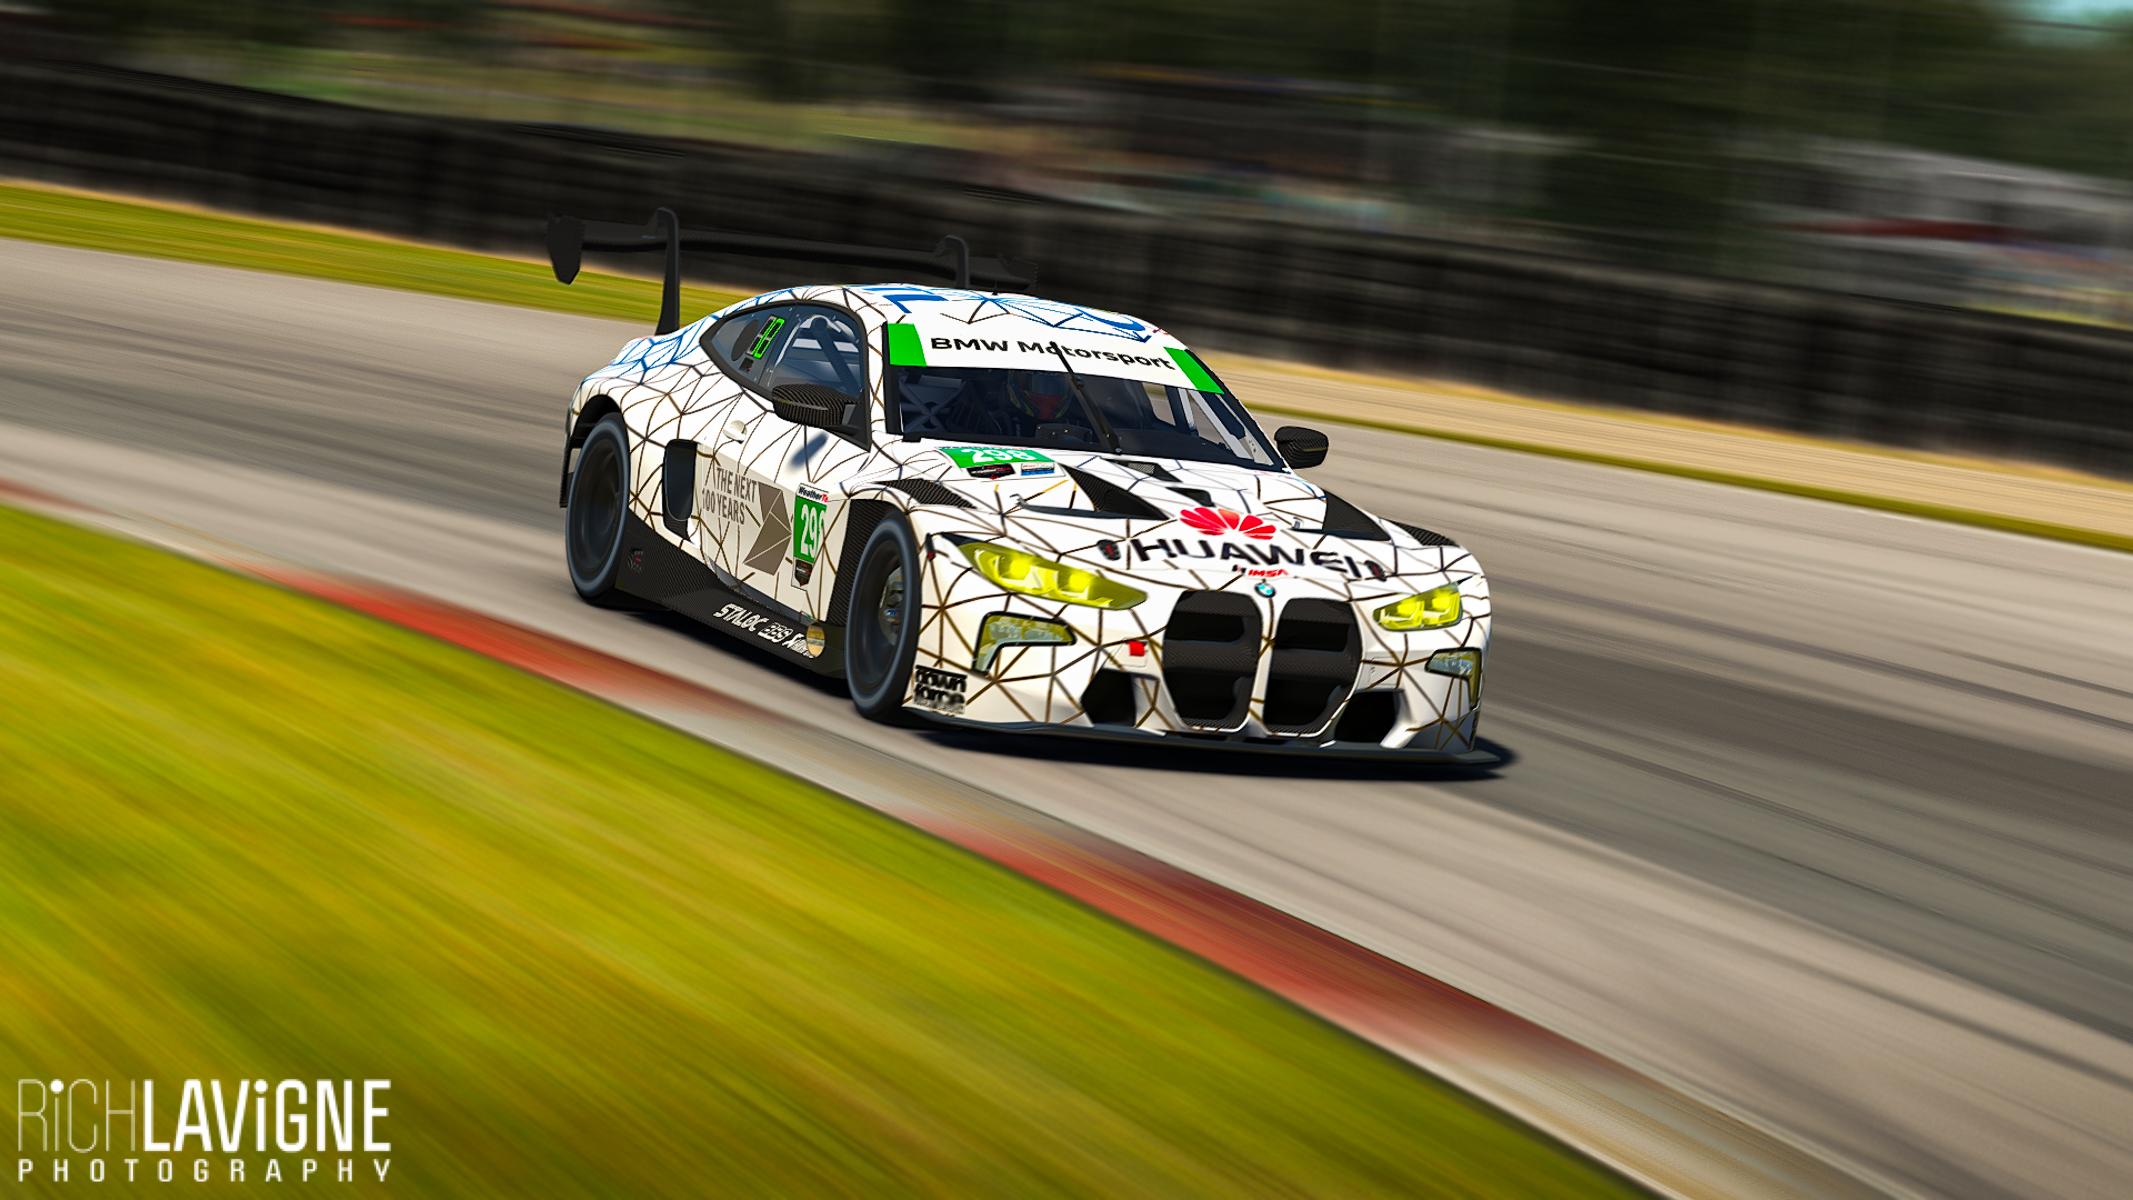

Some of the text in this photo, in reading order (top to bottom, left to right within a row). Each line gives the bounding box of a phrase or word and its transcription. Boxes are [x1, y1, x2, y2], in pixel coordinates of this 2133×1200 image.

[930, 336, 1176, 371] BMW Motorsport
[960, 448, 1037, 464] 298
[716, 467, 758, 503] THE NEXT
[702, 488, 746, 525] 100 YEARS
[1129, 537, 1363, 579] HUAWEI
[1247, 568, 1289, 578] IMSA
[713, 603, 769, 632] STALOC
